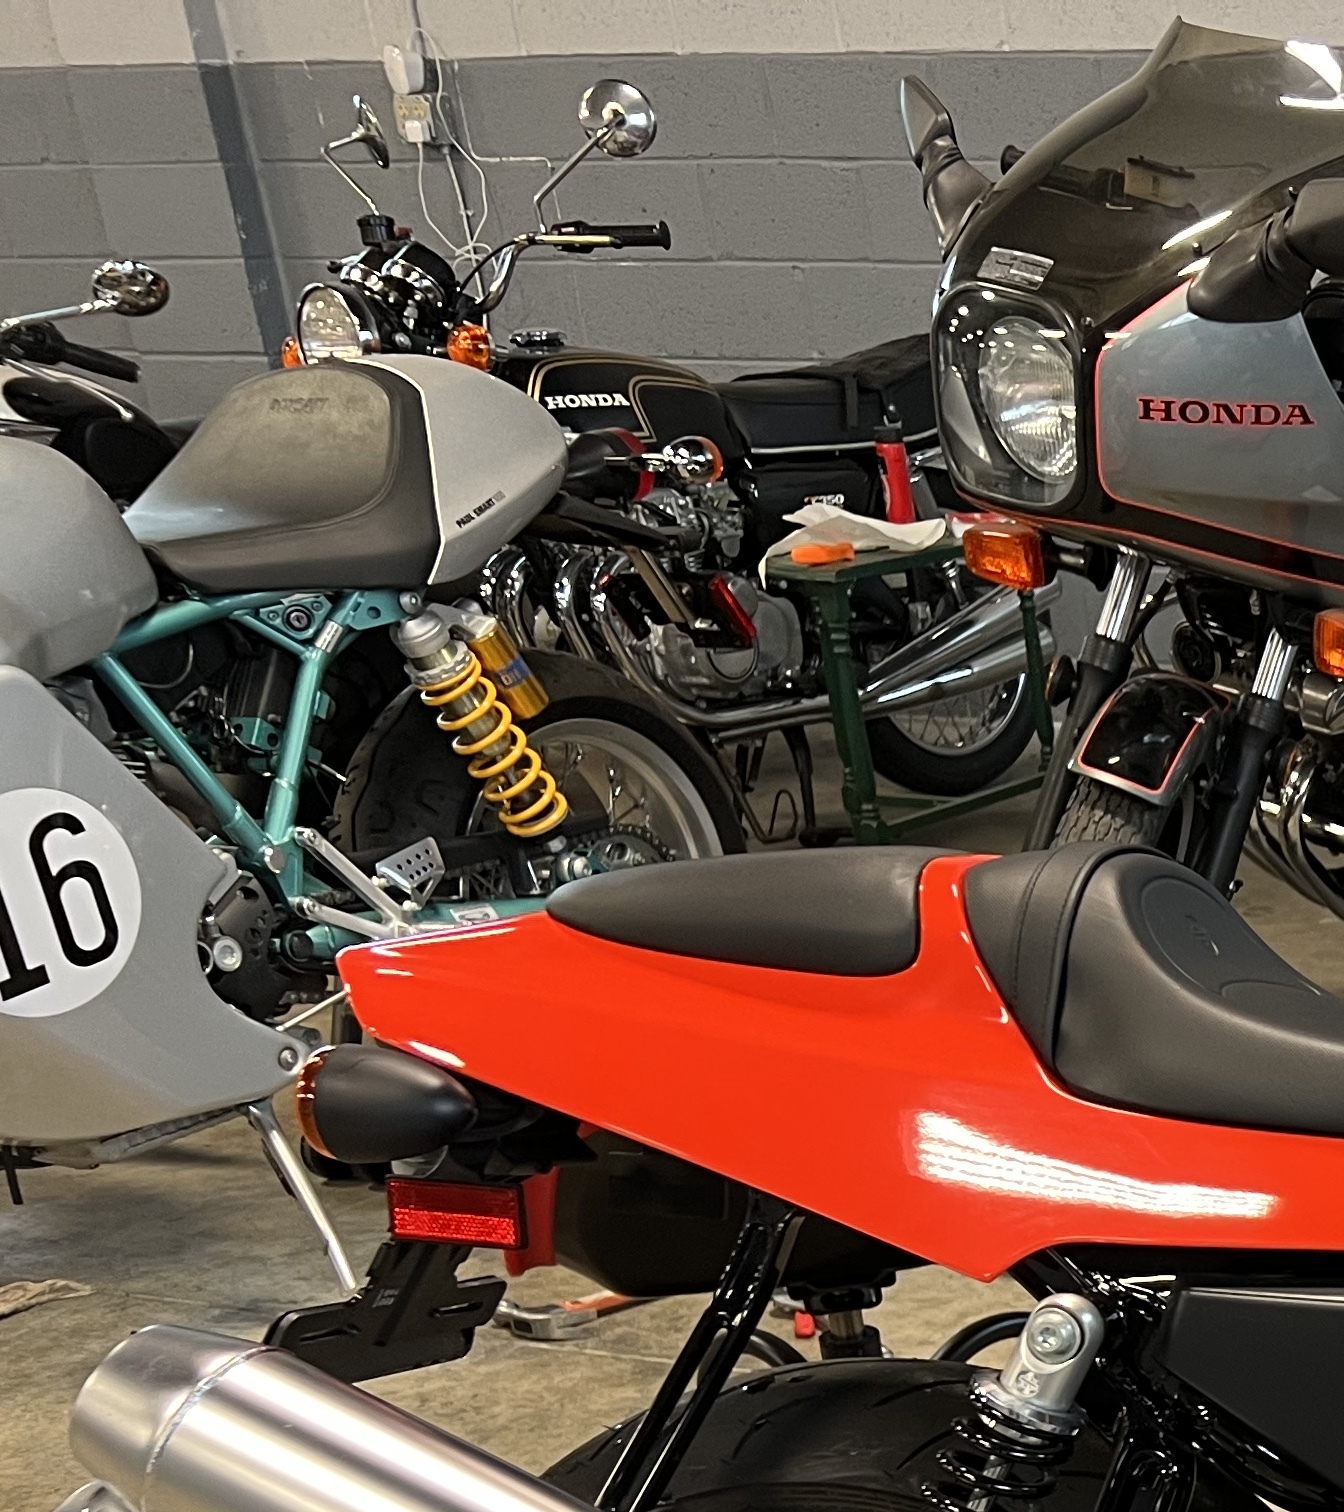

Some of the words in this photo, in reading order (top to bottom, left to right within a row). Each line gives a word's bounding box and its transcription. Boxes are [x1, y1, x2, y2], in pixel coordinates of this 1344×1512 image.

[544, 393, 631, 410] HONDA
[1137, 396, 1317, 428] HONDA
[0, 812, 119, 1001] 16
